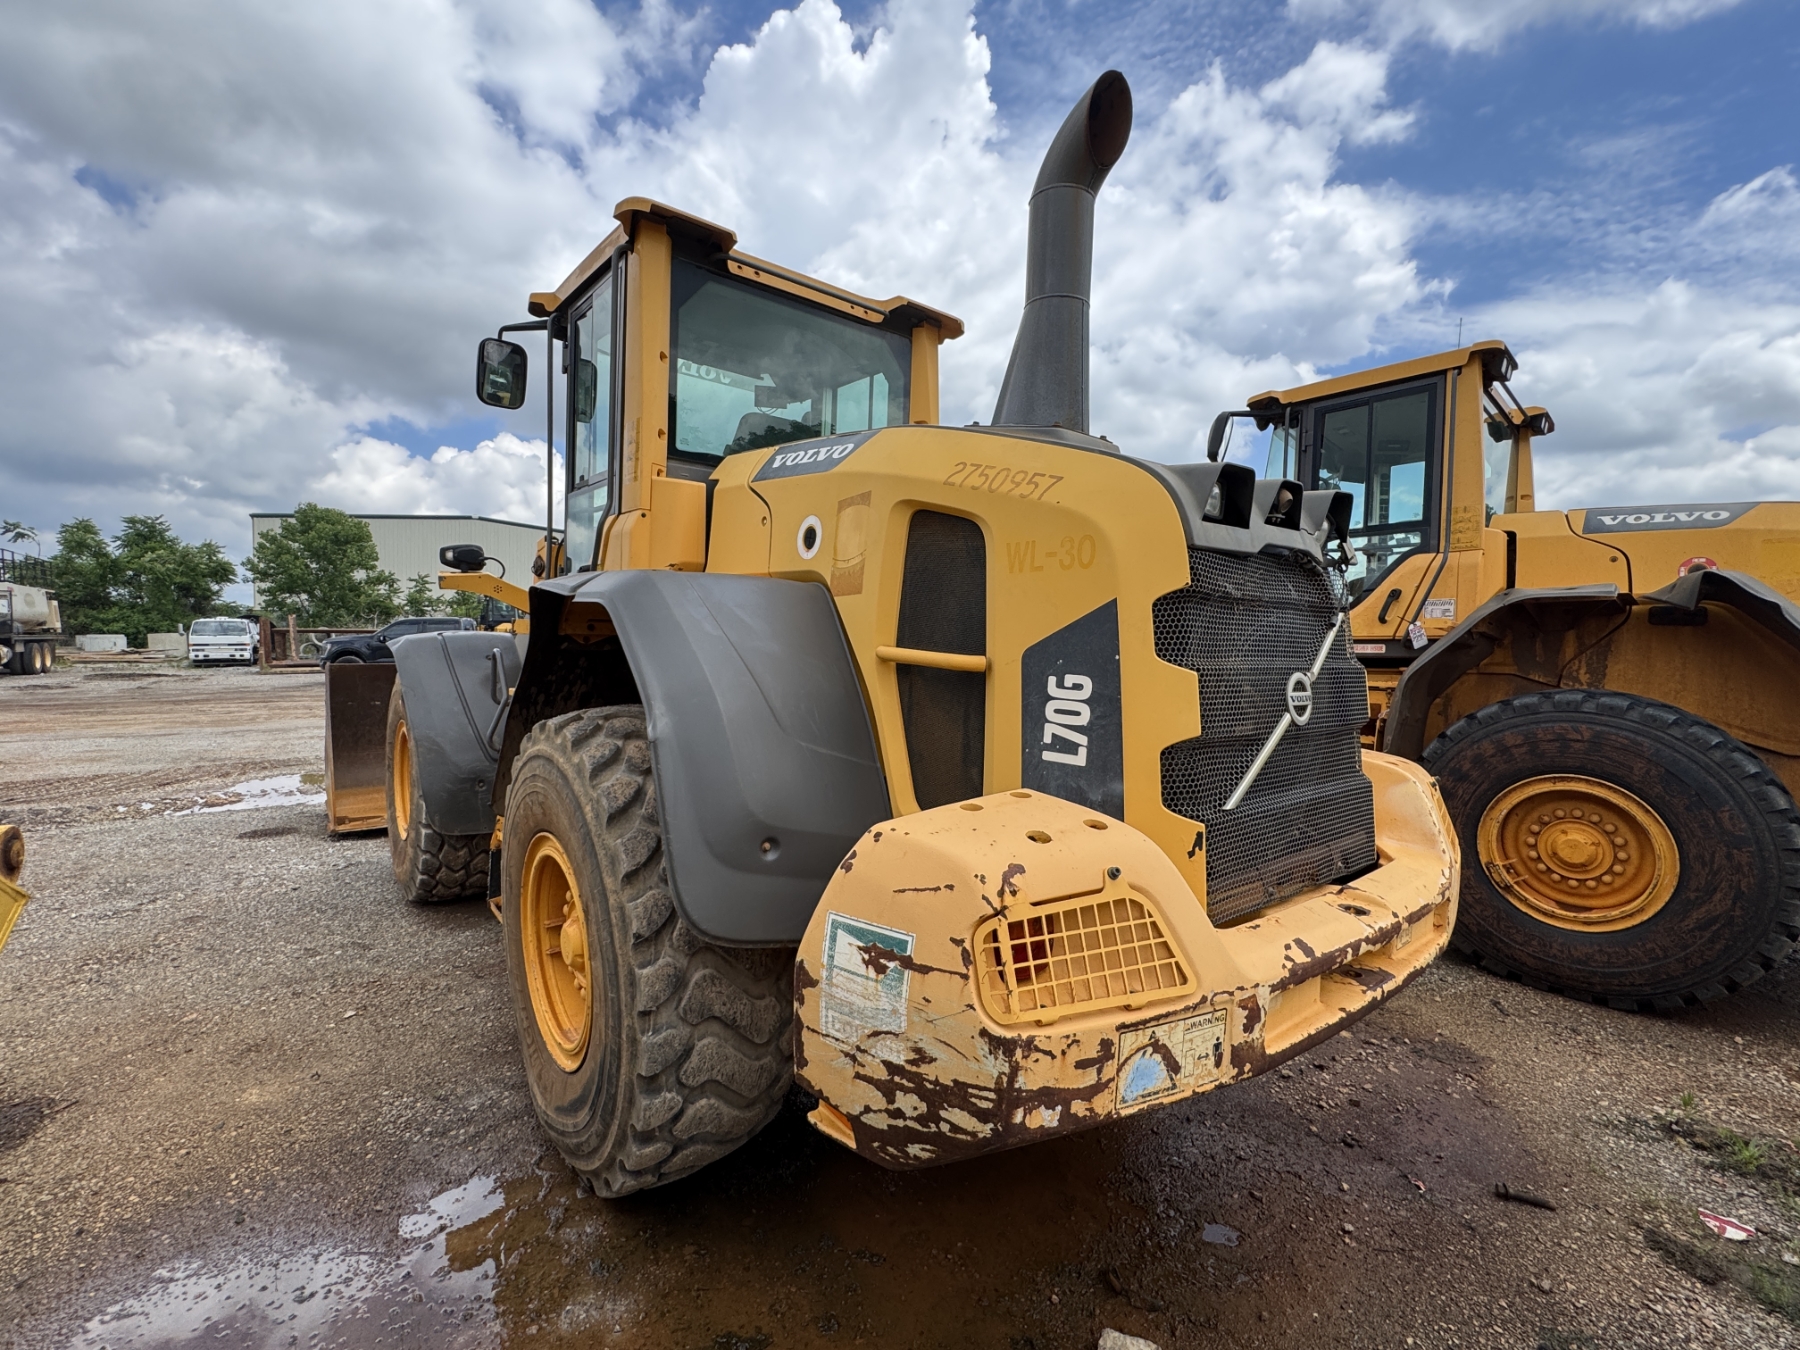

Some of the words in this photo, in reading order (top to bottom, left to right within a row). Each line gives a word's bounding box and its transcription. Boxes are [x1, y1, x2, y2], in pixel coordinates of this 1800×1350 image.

[771, 443, 855, 469] VOLVO
[943, 461, 1065, 501] 2750957
[1597, 510, 1731, 526] VOLVO
[1006, 534, 1097, 574] WL-30
[1042, 674, 1093, 767] L70G
[1191, 1014, 1225, 1030] WARNNG
